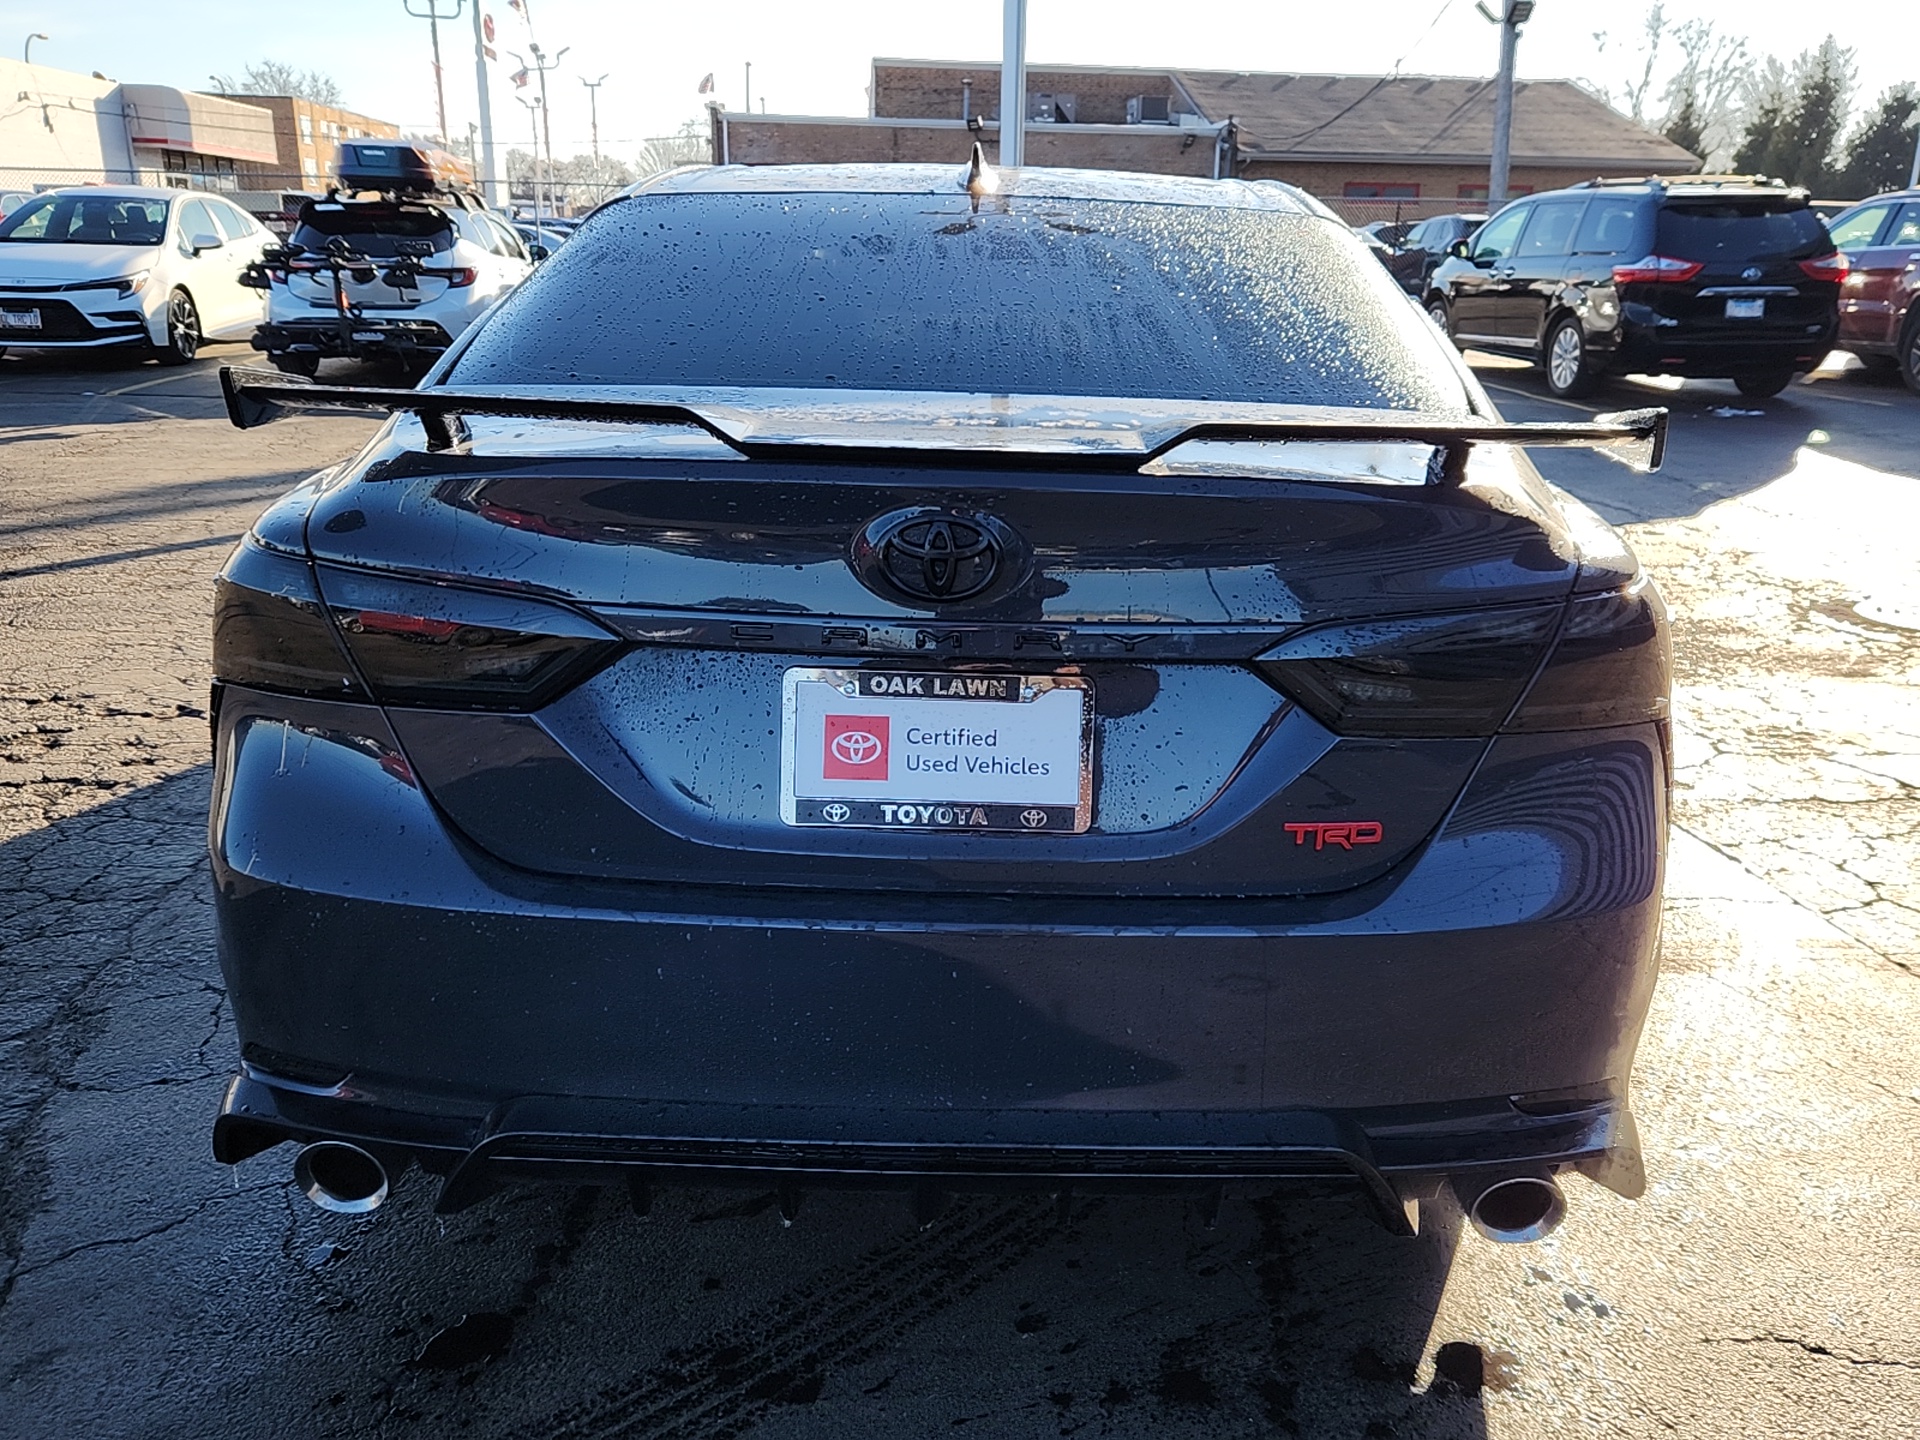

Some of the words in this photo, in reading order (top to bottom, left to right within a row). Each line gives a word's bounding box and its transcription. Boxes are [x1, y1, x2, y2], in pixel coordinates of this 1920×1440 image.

[729, 623, 1158, 652] CAMRY
[870, 675, 925, 694] OAK
[933, 678, 1007, 697] LAWN
[906, 727, 998, 747] Certified
[906, 754, 958, 772] Used
[964, 755, 1050, 775] Vehicles
[880, 804, 988, 825] TOYOTA
[1284, 822, 1383, 850] TRD
